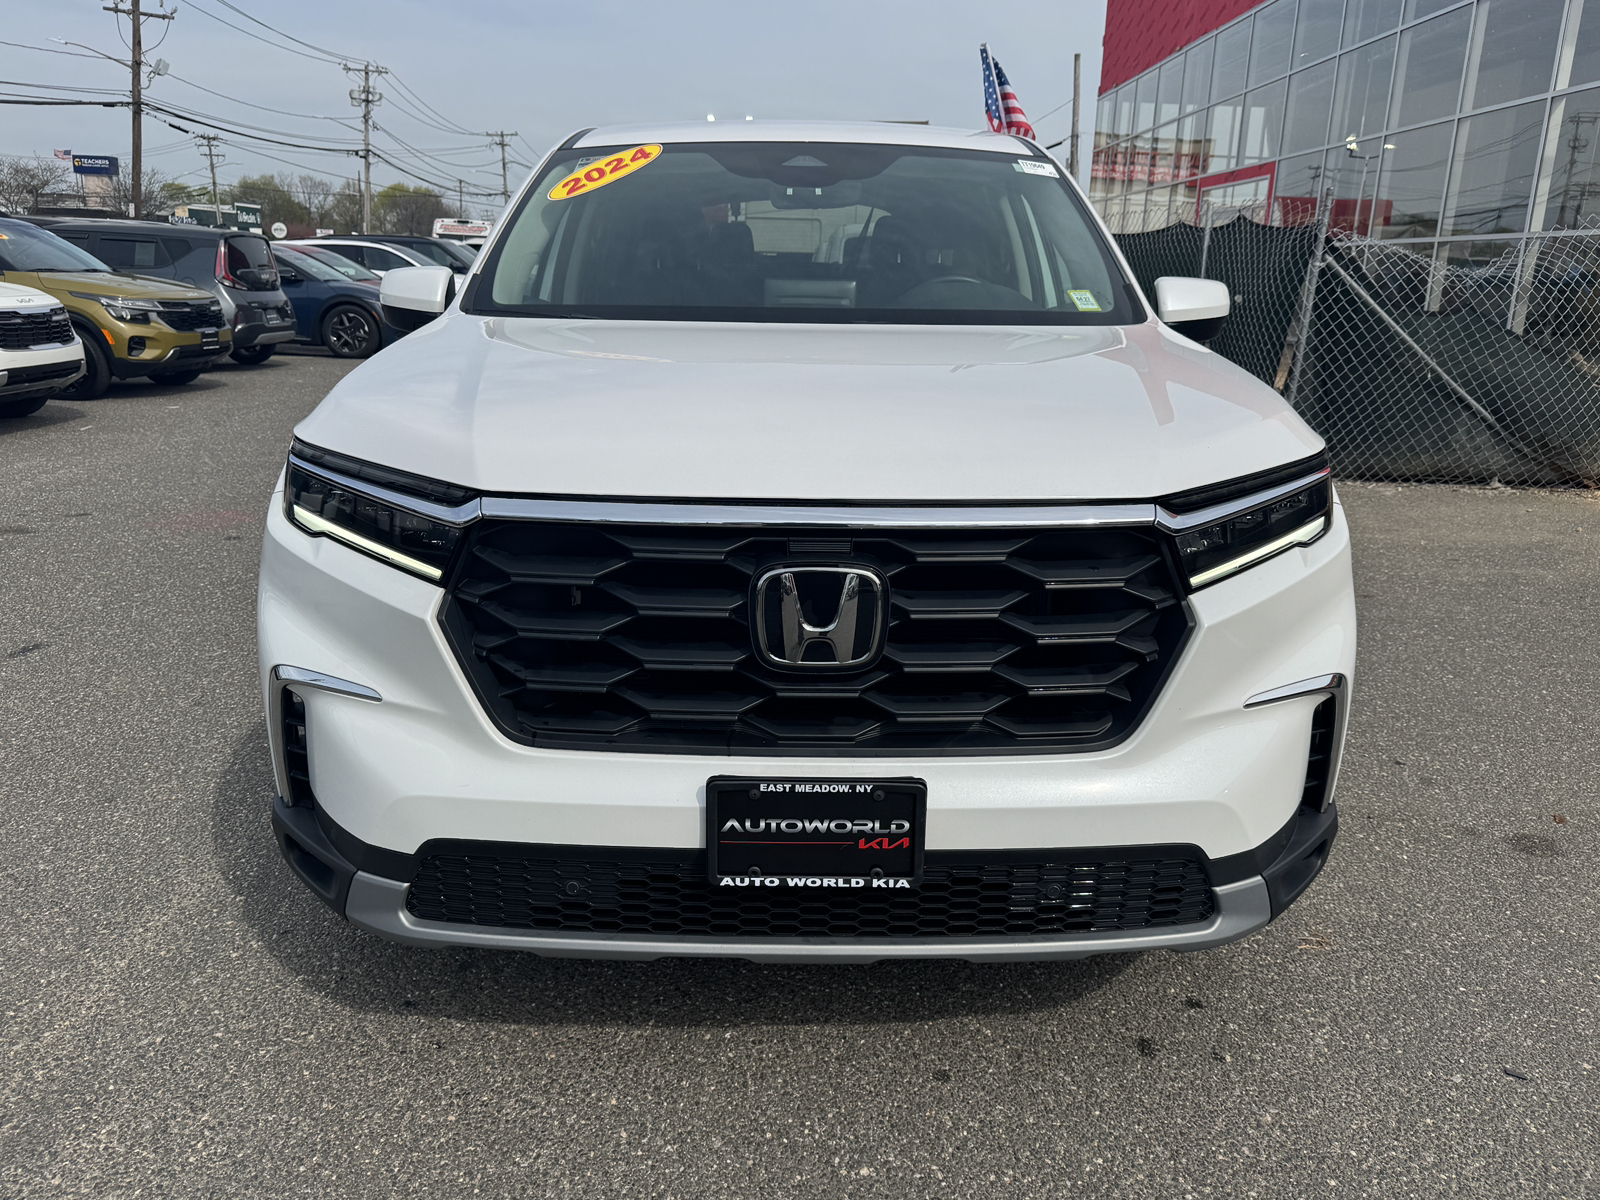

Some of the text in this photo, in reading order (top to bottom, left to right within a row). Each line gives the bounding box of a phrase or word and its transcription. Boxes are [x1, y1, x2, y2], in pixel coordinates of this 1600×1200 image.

[561, 147, 653, 196] 2024
[759, 783, 792, 793] EAST
[855, 784, 873, 793] NY
[720, 817, 910, 834] AUTOWORLD
[858, 837, 910, 849] KIA
[719, 876, 911, 889] AUTO WORLD KIA
